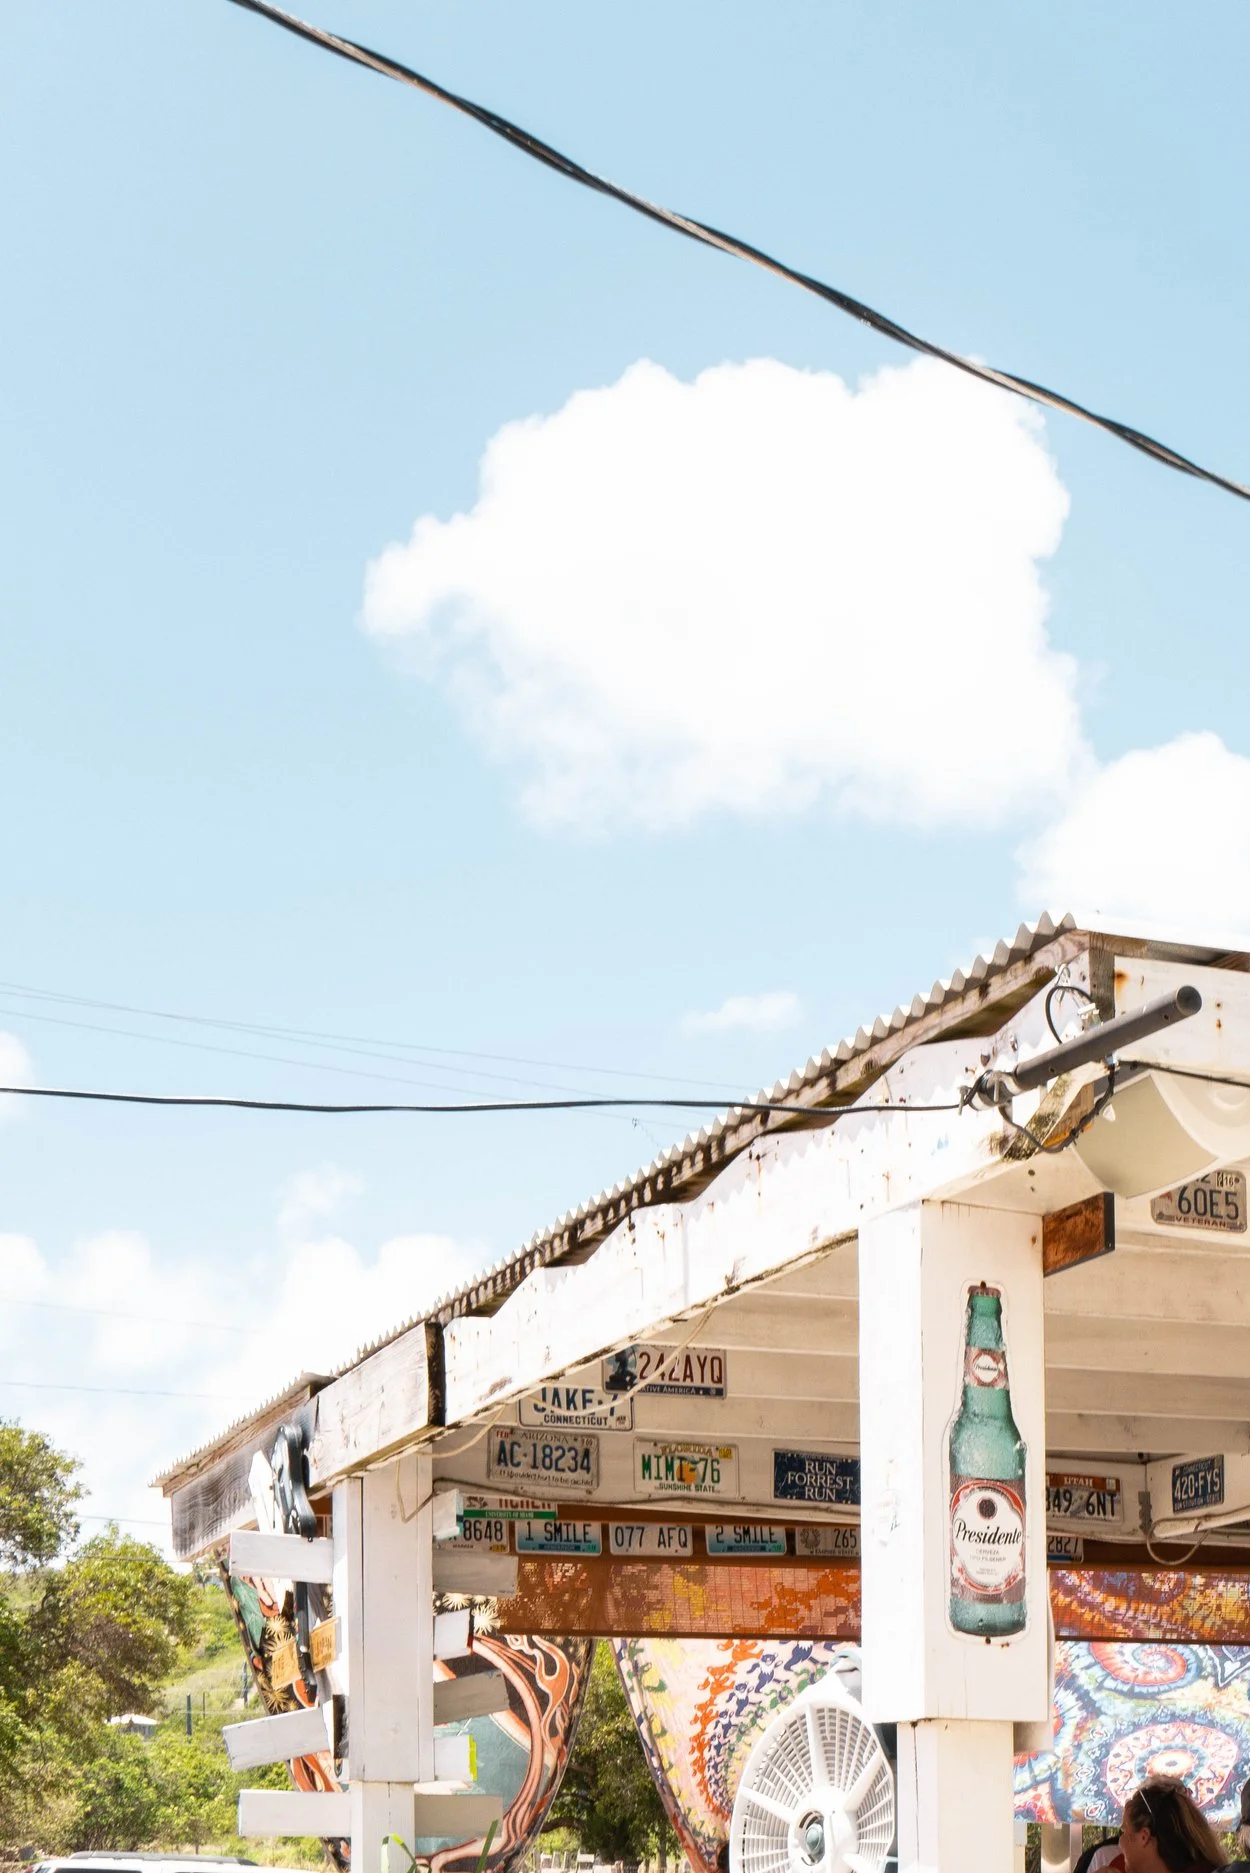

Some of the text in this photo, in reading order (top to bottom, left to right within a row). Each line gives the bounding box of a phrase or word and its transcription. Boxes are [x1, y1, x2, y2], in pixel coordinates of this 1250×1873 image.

[1174, 1216, 1226, 1228] VETERAN
[640, 1384, 696, 1394] ATIVE AMERICA
[544, 1414, 608, 1426] CONNECTICUT
[521, 1432, 569, 1444] ARIZONA
[805, 1460, 836, 1475] RUN
[658, 1482, 716, 1493] SUNSHINE STATE
[787, 1471, 853, 1490] FORREST
[1063, 1477, 1094, 1487] UTAH
[805, 1487, 836, 1501] RUN
[463, 1519, 504, 1542] 8648
[525, 1521, 592, 1544] 1 SMILE
[734, 1526, 778, 1544] SMILE
[952, 1518, 1022, 1546] Presidente
[657, 1527, 688, 1549] AFQ
